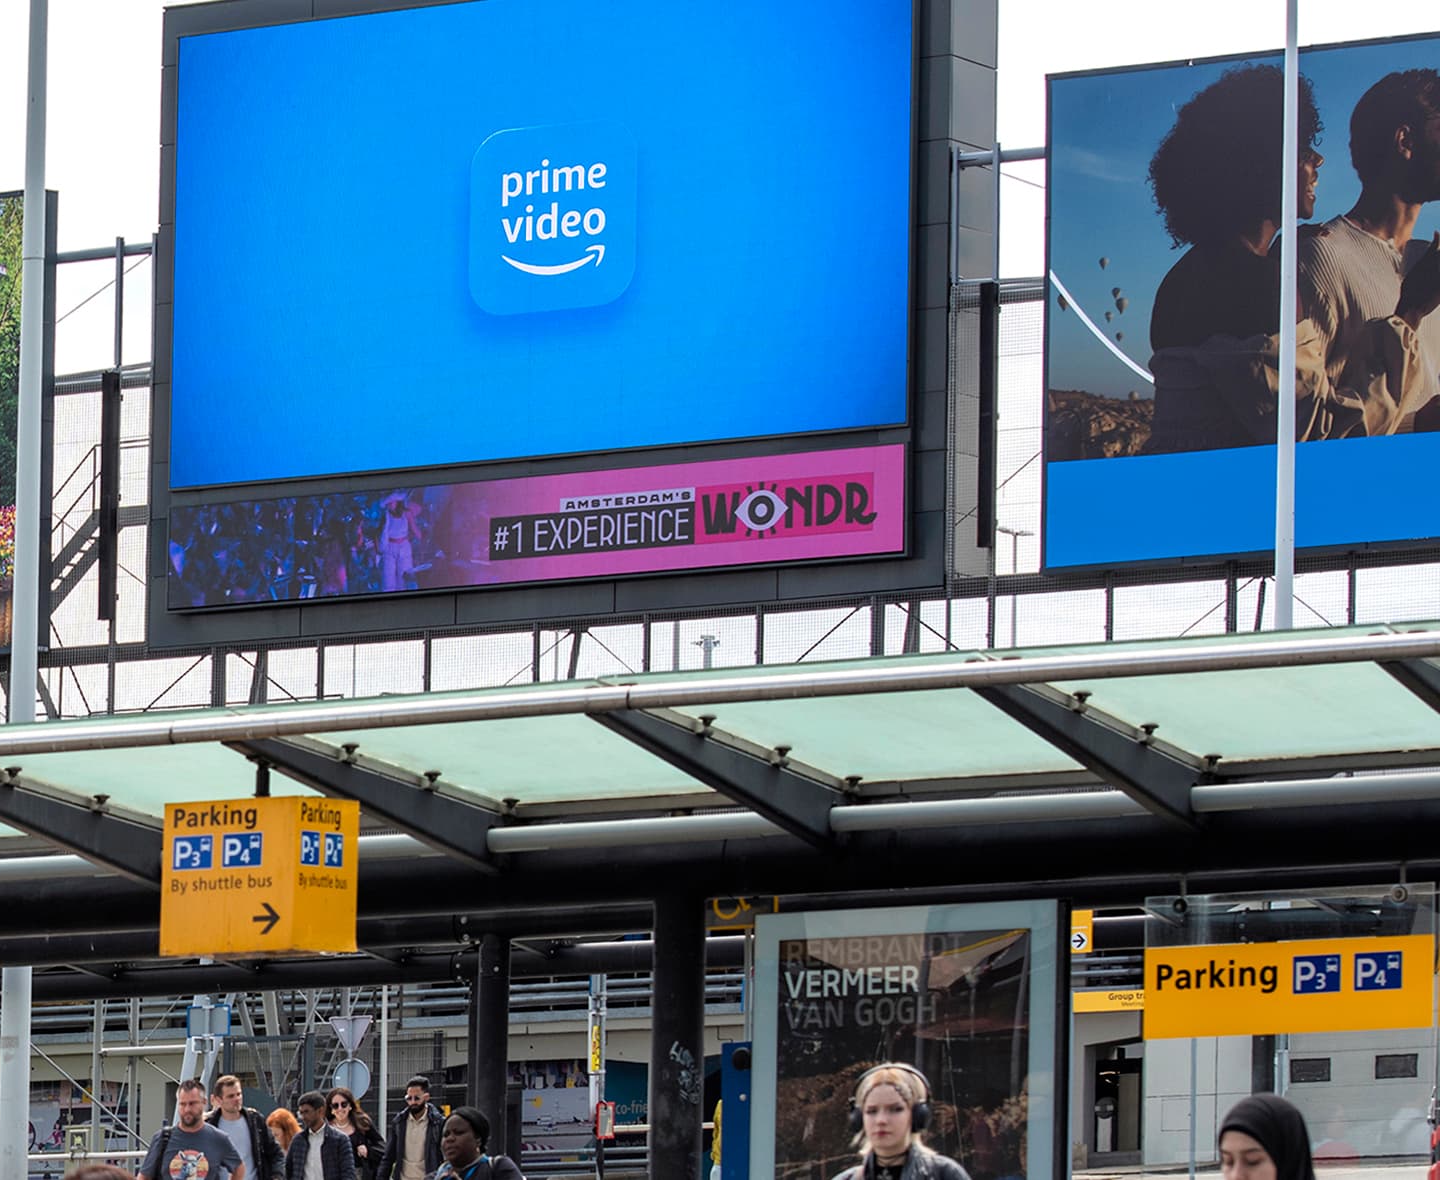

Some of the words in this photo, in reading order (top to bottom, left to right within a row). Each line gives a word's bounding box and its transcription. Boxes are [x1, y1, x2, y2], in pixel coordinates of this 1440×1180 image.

[501, 158, 607, 207] prime
[501, 202, 607, 243] video
[565, 491, 691, 511] AMSTERDAM'S
[494, 522, 523, 553] #1
[533, 507, 689, 552] EXPERIENCE
[173, 804, 258, 830] Parking
[301, 802, 341, 831] Parking
[171, 879, 188, 895] By
[192, 875, 243, 892] shuttle
[248, 874, 273, 888] bus
[787, 933, 964, 967] REMBRANDT
[784, 965, 919, 999] VERMEER
[1156, 960, 1278, 994] Parking
[785, 1001, 844, 1029] VAN
[855, 995, 936, 1026] GOGH
[1108, 992, 1134, 1001] Group
